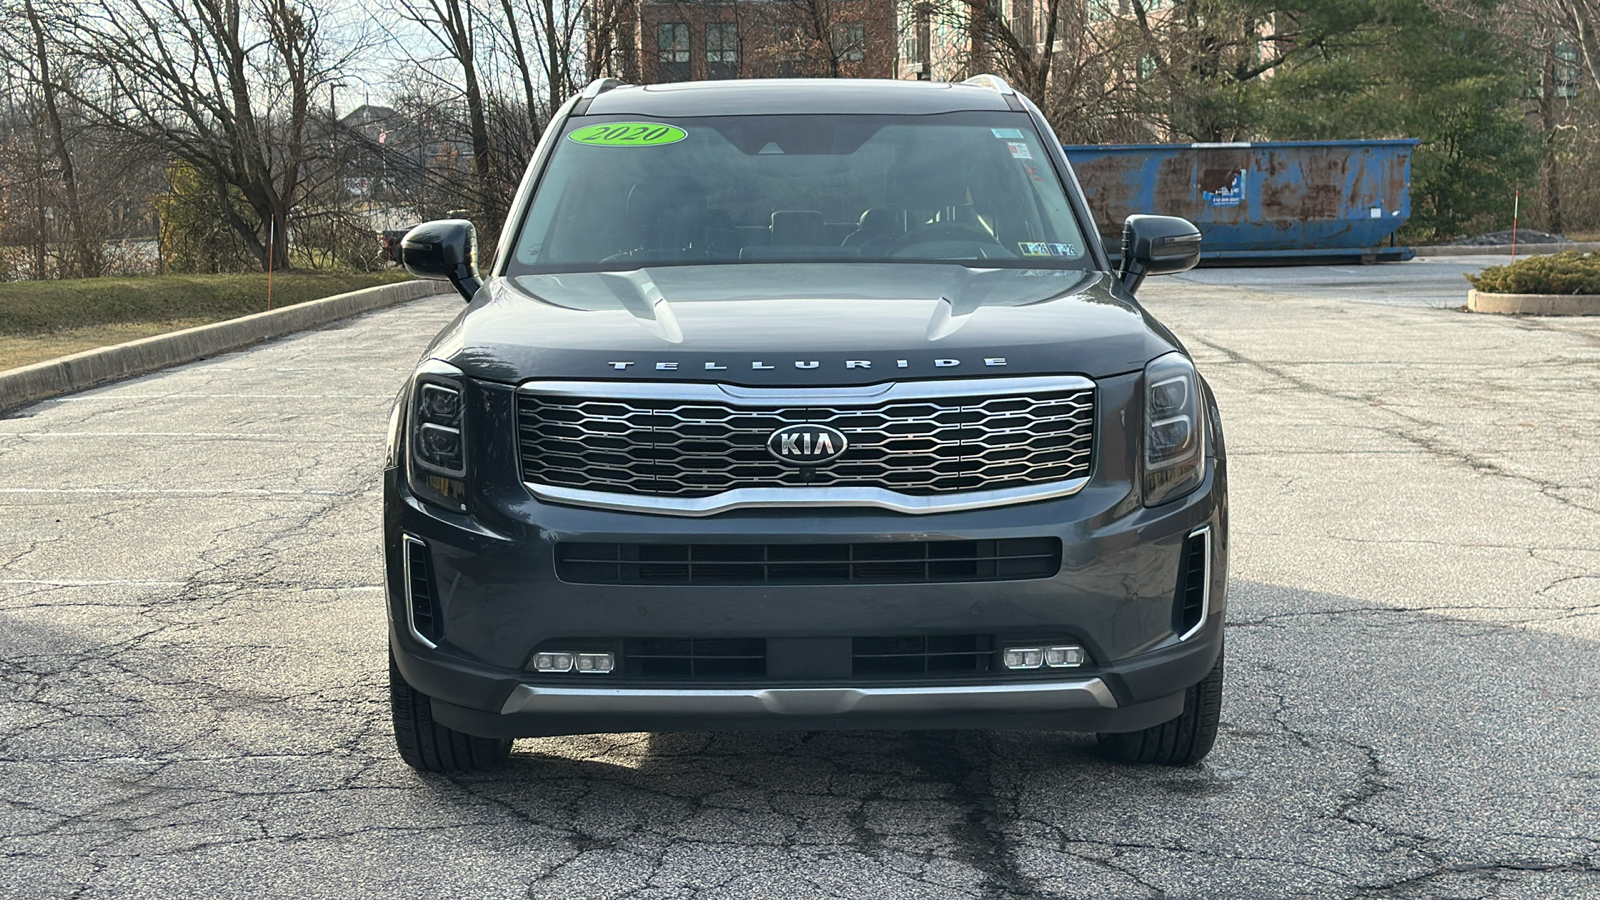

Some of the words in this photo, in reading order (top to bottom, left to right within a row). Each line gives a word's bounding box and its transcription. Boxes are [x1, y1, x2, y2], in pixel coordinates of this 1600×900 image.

[581, 126, 670, 141] 2020
[607, 356, 1008, 371] TELLURIDE
[780, 432, 835, 455] KIA
